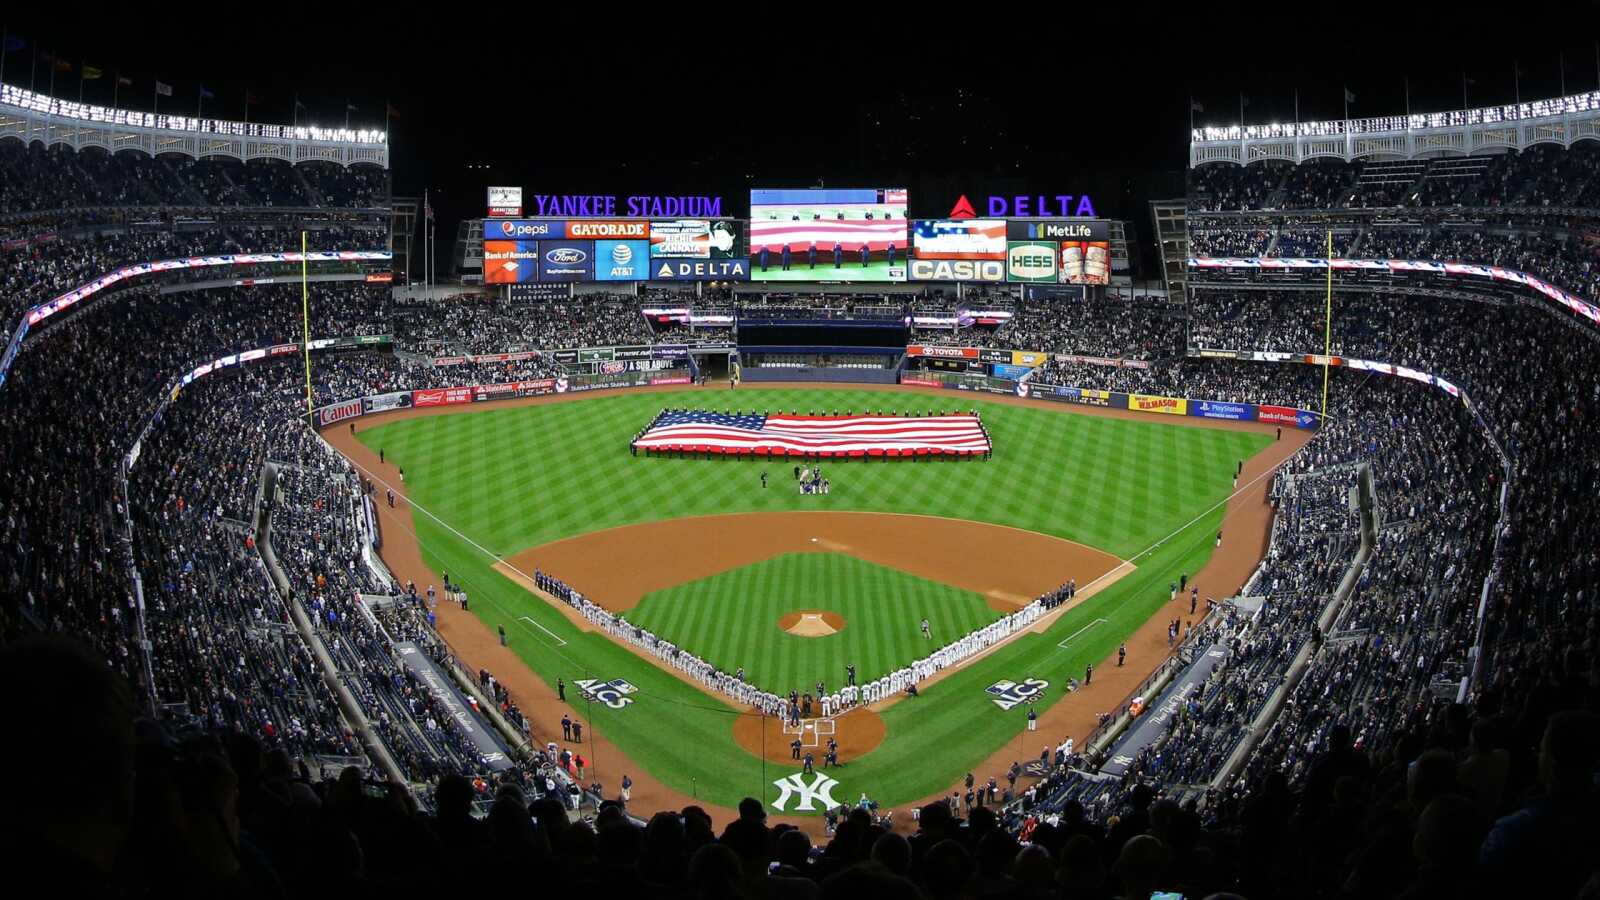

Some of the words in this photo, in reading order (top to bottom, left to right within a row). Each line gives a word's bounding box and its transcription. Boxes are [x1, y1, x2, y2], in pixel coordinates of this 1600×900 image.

[533, 195, 616, 217] YANKEE
[627, 196, 722, 217] STADIUM
[988, 195, 1095, 217] DELTA
[517, 224, 548, 236] pepsi
[571, 224, 644, 236] GATORADE
[1047, 225, 1091, 237] MetLife
[485, 251, 502, 259] Bank
[503, 251, 510, 259] of
[510, 251, 537, 259] America
[553, 251, 578, 262] Ford
[1012, 256, 1053, 268] HESS
[611, 267, 634, 276] AT&T
[679, 263, 744, 276] DELTA
[911, 260, 1003, 281] CASIO
[629, 361, 635, 370] A
[635, 361, 650, 370] SUB
[651, 360, 674, 369] ABOVE
[320, 402, 361, 423] Canon
[1211, 404, 1244, 413] PlayStation
[1280, 412, 1301, 422] America
[771, 771, 842, 812] NY
